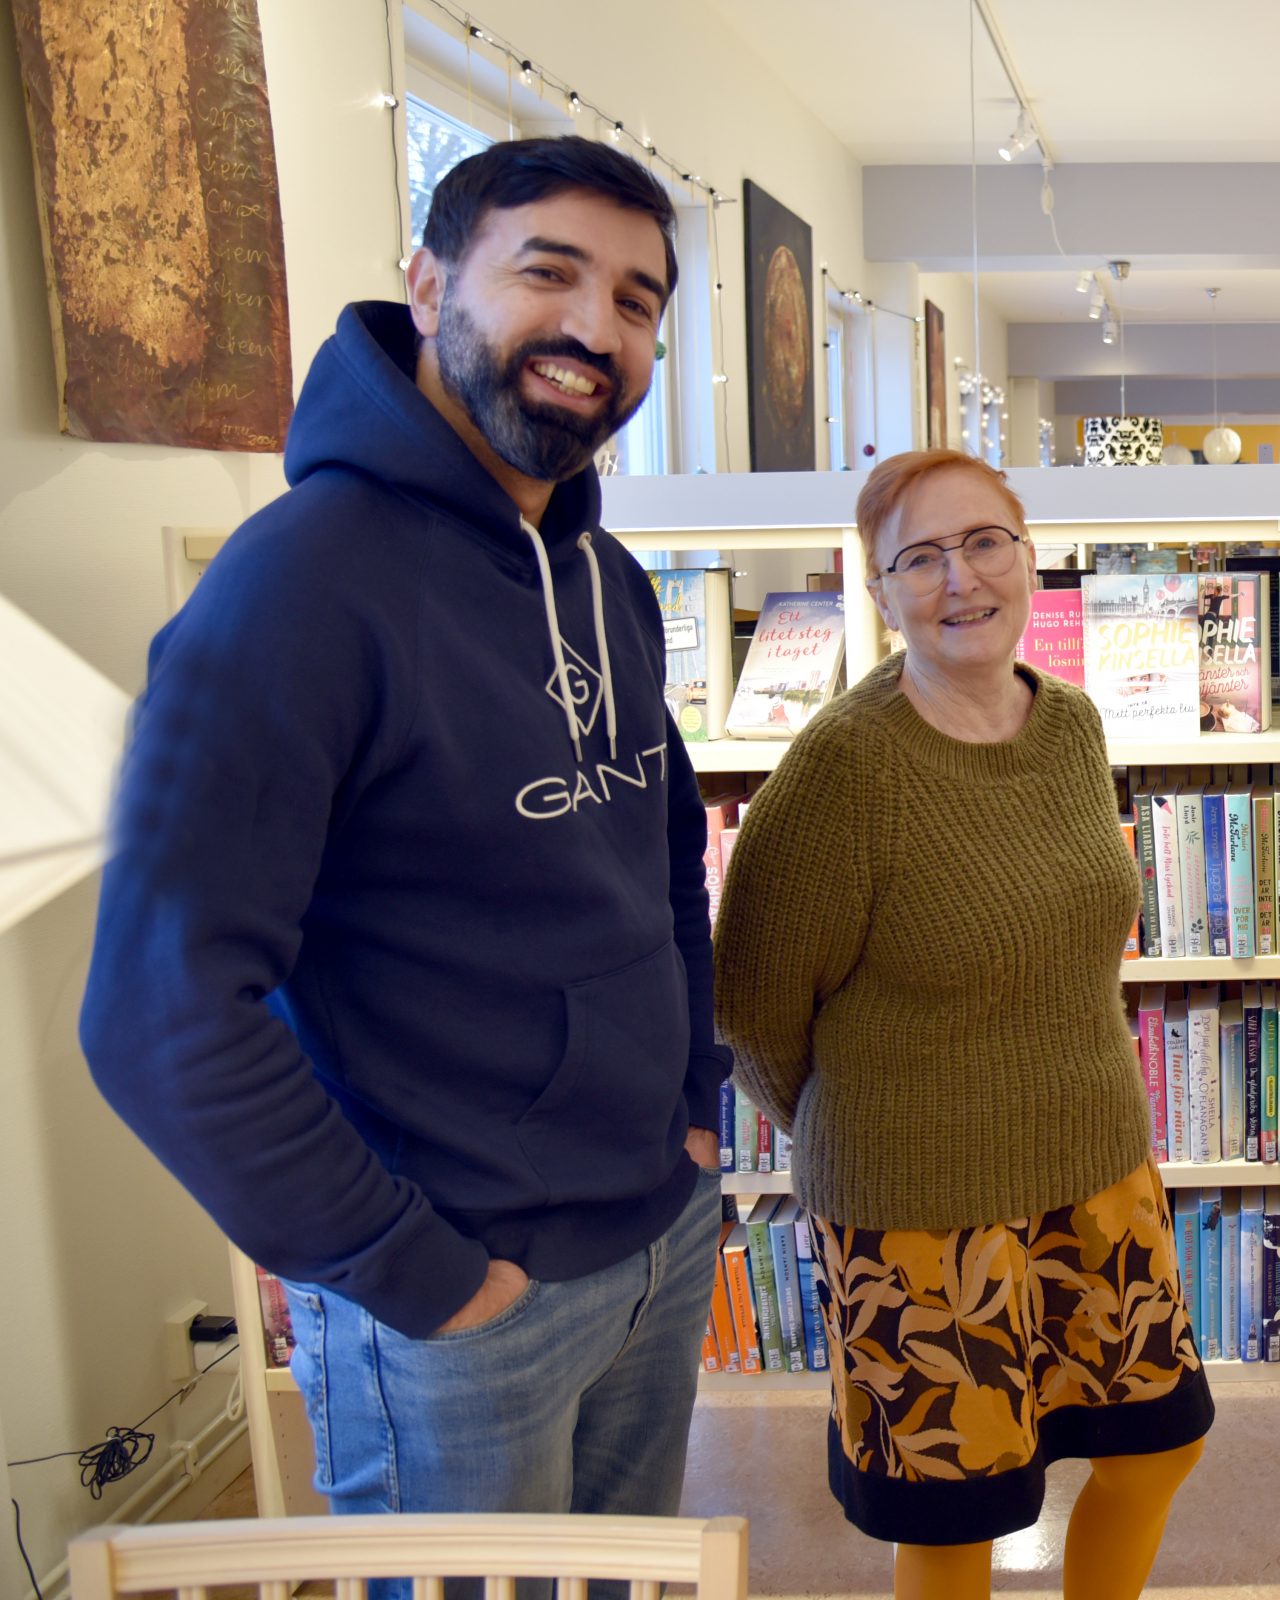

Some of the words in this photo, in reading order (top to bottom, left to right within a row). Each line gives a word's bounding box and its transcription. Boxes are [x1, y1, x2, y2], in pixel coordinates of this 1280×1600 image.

[811, 600, 834, 608] CENTER
[778, 610, 801, 625] Ett
[1032, 610, 1065, 620] DENISE
[1032, 620, 1060, 629] HUGO
[664, 622, 693, 635] örunderliga
[758, 627, 795, 643] litet
[798, 625, 833, 641] steg
[1096, 616, 1197, 651] SOPHIE
[775, 642, 819, 661] taget
[1033, 637, 1053, 652] En
[1200, 643, 1257, 666] SELLA
[1098, 643, 1197, 672] KINSELLA
[1132, 704, 1178, 721] perfekta
[515, 742, 668, 820] GANT
[1183, 805, 1191, 825] Lloyd
[1228, 813, 1241, 863] McFarlane
[1260, 833, 1270, 873] McFarlane
[1260, 911, 1272, 919] DET
[1147, 1016, 1160, 1053] Elizabeth
[1148, 1053, 1159, 1087] NOBLE
[1172, 1053, 1184, 1081] Inte
[1170, 1084, 1184, 1106] för
[1174, 1110, 1185, 1145] nära
[779, 1235, 787, 1254] KARIN
[758, 1254, 767, 1280] JANSON
[782, 1257, 790, 1281] JANSON
[784, 1287, 792, 1304] SWEET
